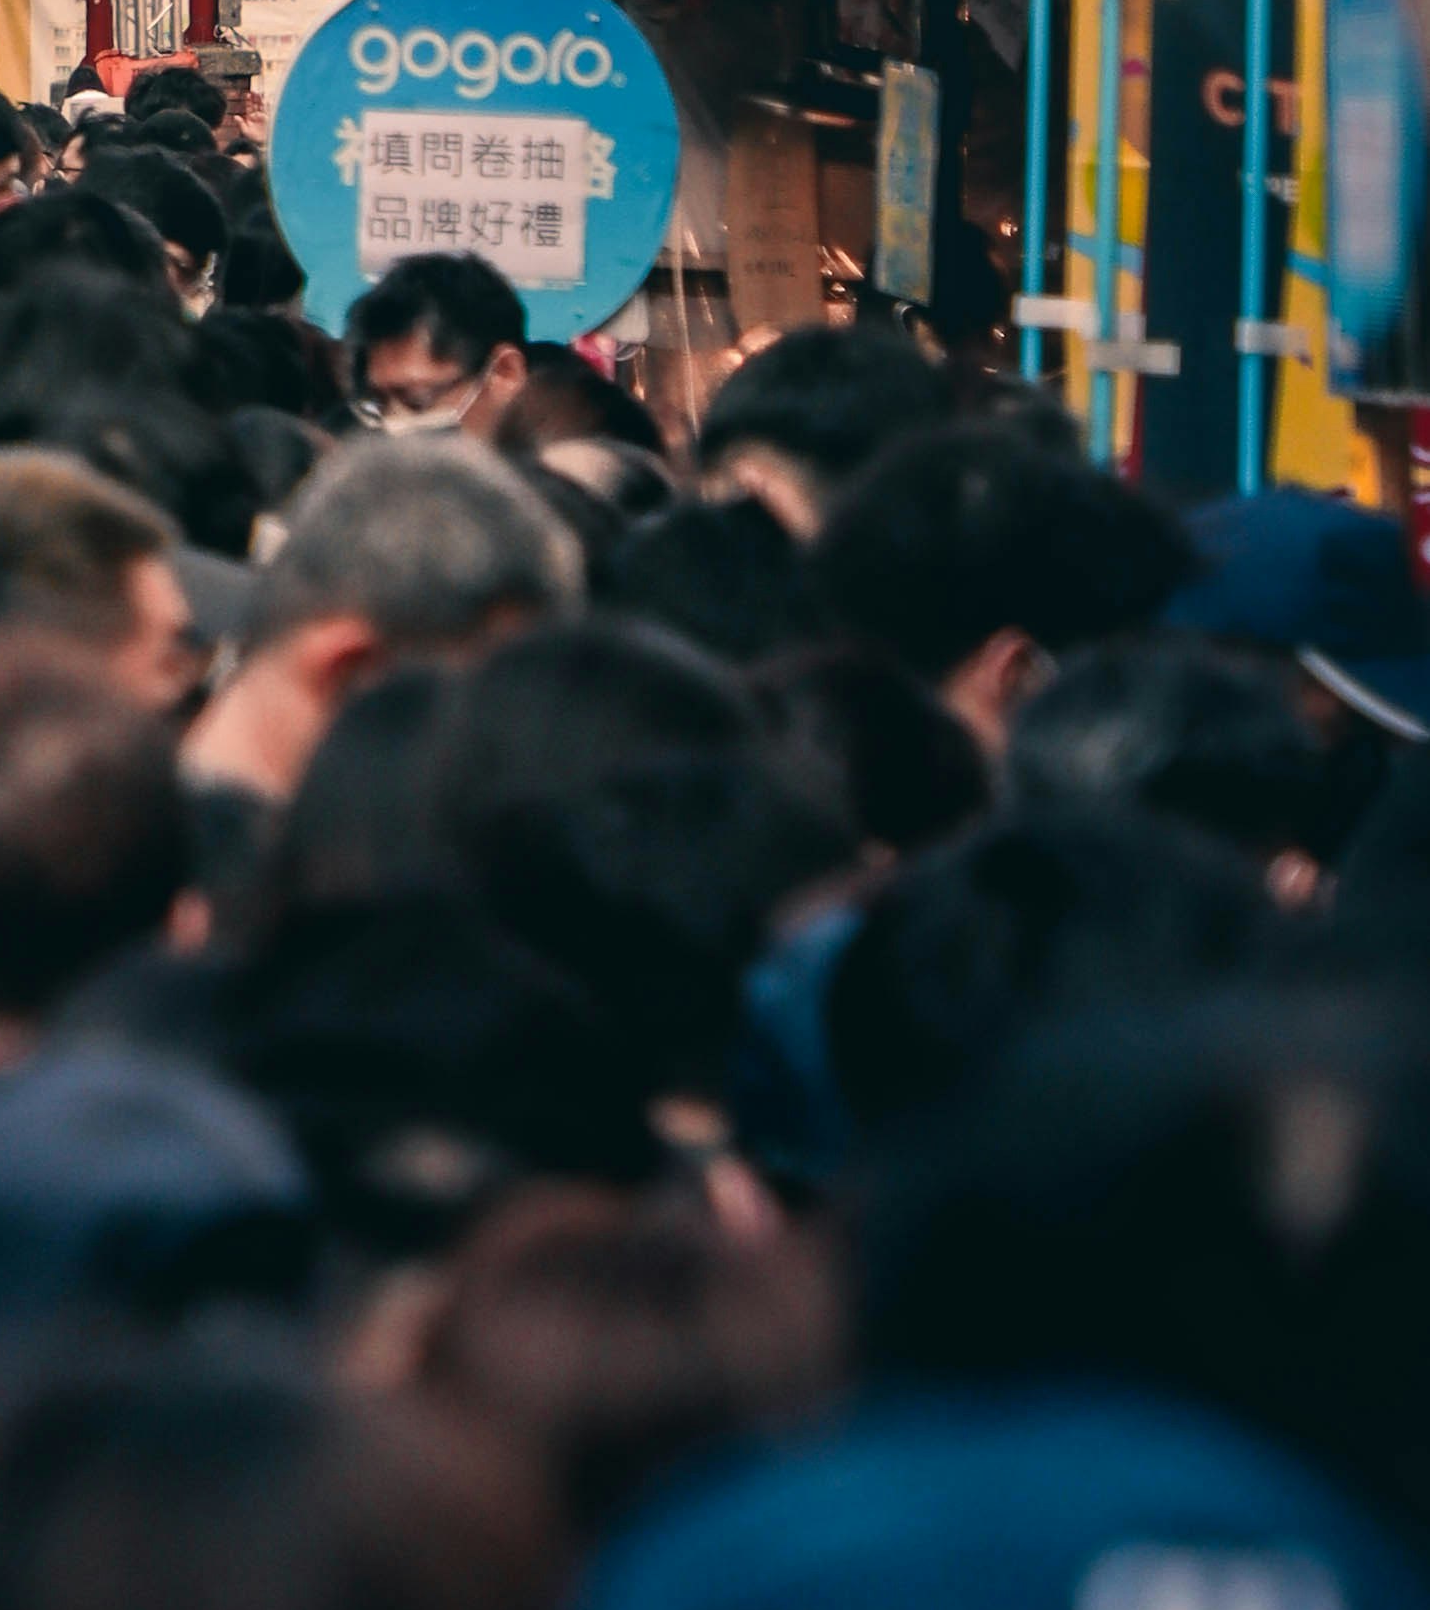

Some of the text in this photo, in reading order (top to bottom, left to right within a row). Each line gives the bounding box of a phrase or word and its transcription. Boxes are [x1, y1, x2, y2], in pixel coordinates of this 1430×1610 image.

[350, 26, 612, 99] gogoro
[369, 132, 566, 183] 填問卷抽
[369, 197, 566, 250] 品牌好禮
